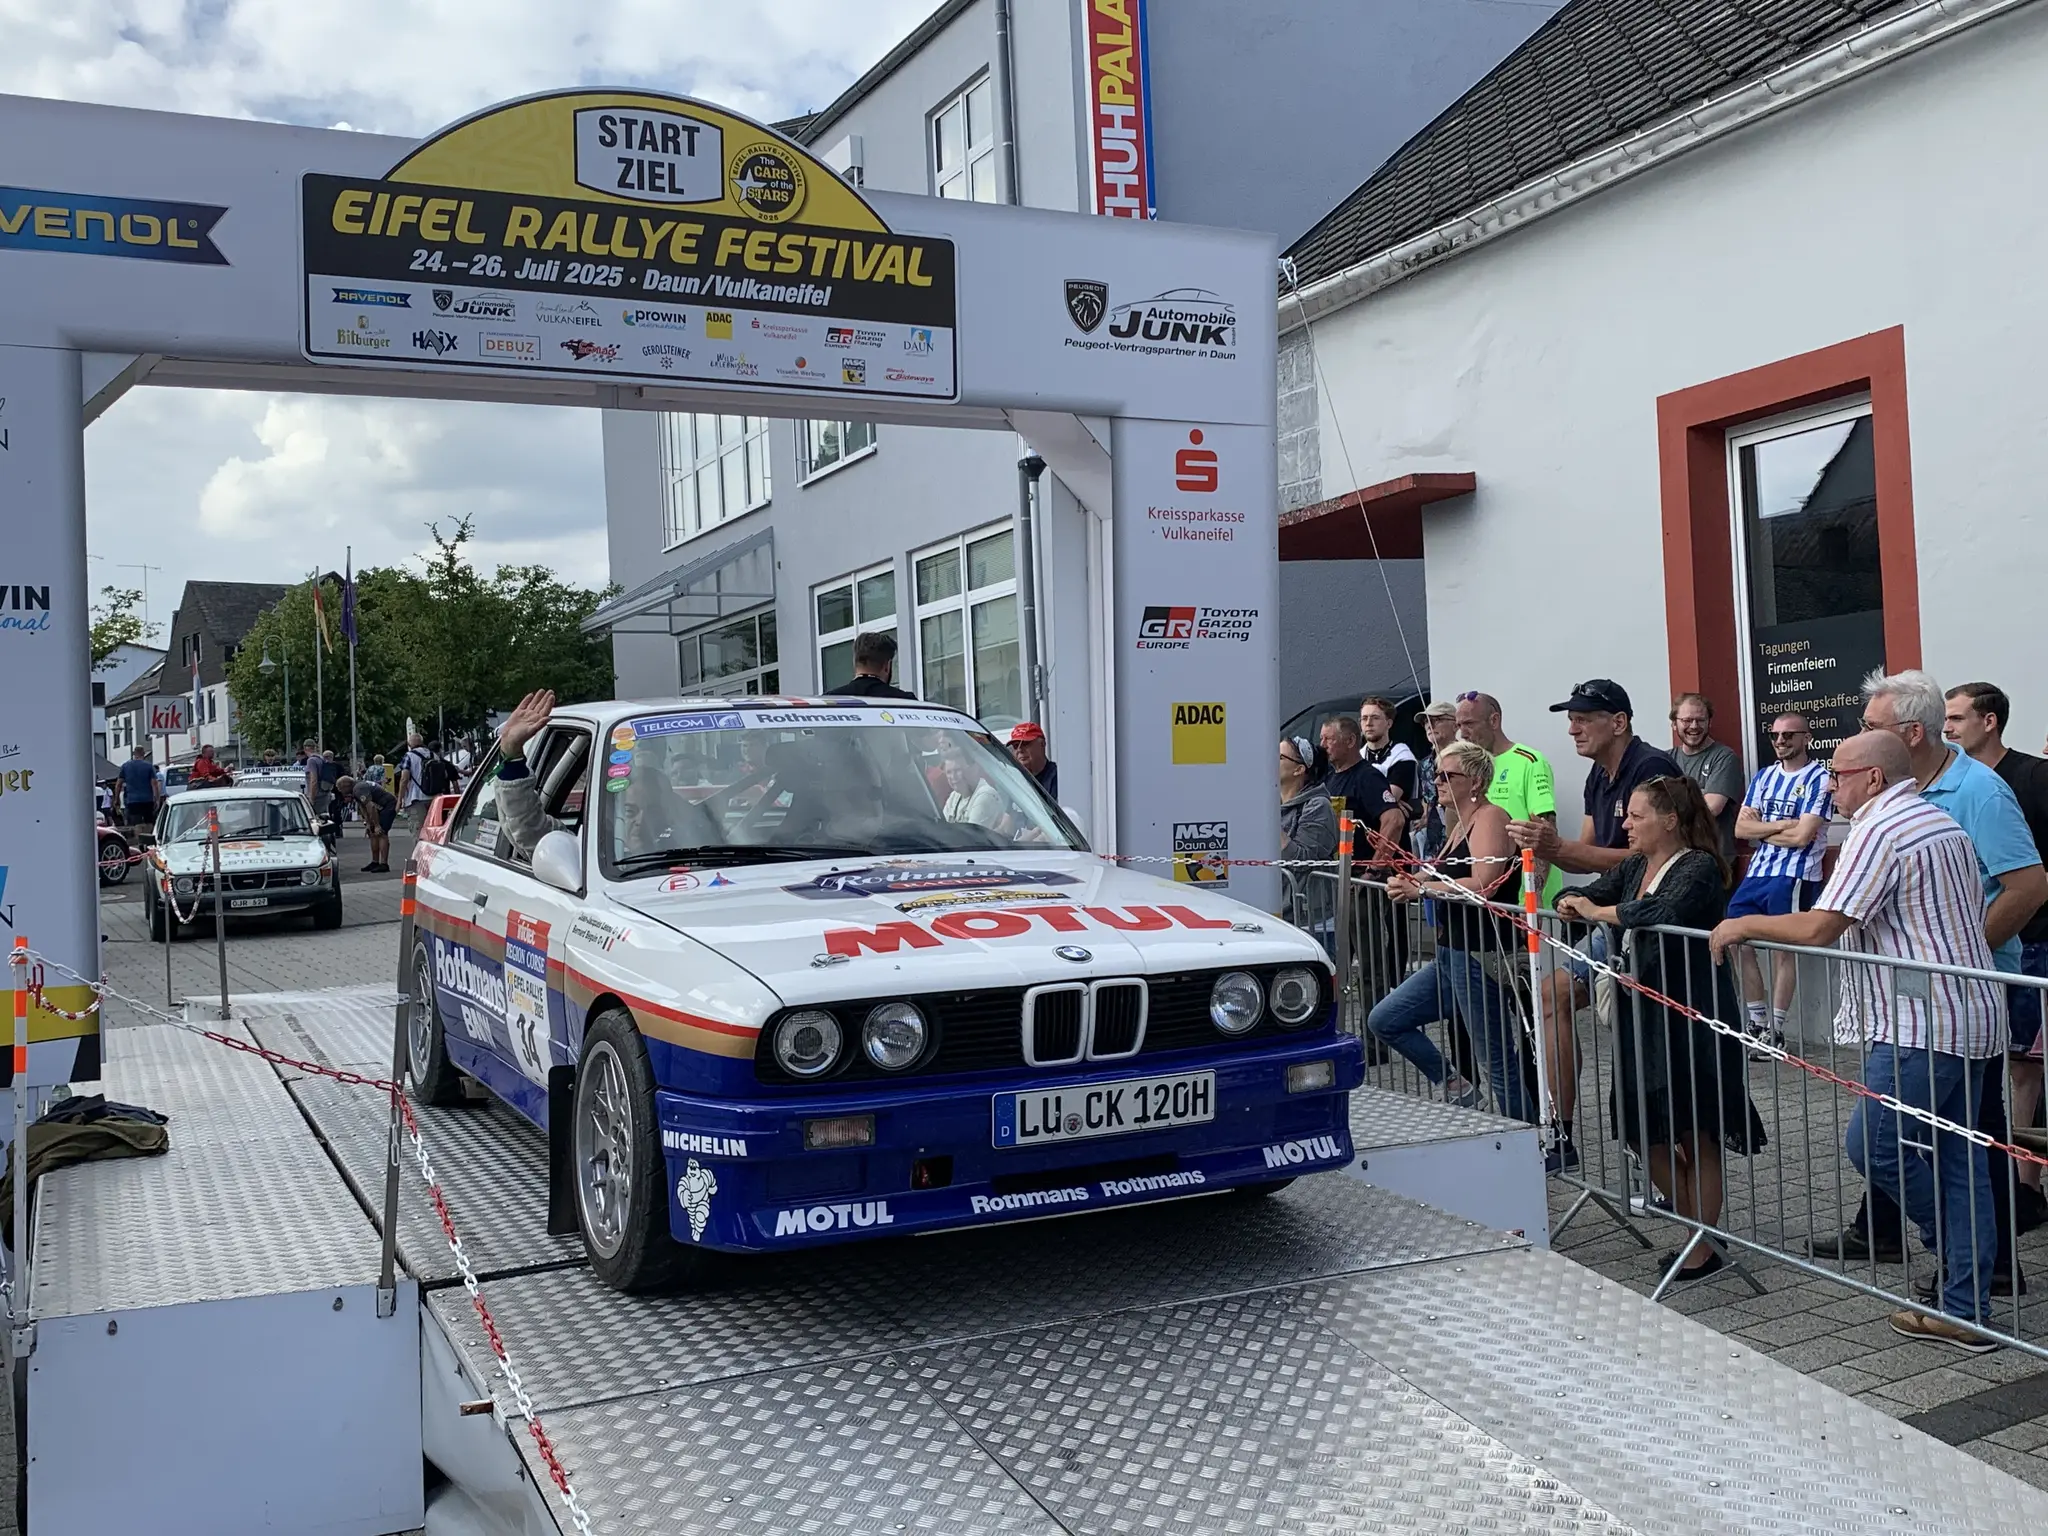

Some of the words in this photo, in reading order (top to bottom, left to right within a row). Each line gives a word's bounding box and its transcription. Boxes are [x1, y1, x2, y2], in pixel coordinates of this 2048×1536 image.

[598, 115, 700, 158] START
[760, 156, 775, 166] The
[616, 156, 685, 195] ZIEL
[754, 165, 788, 180] CARS
[780, 181, 794, 190] the
[747, 187, 789, 202] STARS
[758, 213, 778, 221] 2025
[331, 189, 487, 244] EIFEL
[502, 205, 705, 265] RALLYE
[714, 226, 934, 288] FESTIVAL
[514, 256, 560, 282] Juli
[564, 261, 624, 288] 2025
[642, 269, 832, 308] Daun/Vulkaneifel
[1068, 283, 1105, 292] PEUGEOT
[338, 291, 406, 305] RAVENOL
[453, 301, 512, 317] JUNK
[1147, 307, 1236, 326] Automobile
[536, 313, 603, 327] VULKANEIFEL
[706, 312, 733, 324] ADAC
[856, 329, 887, 337] TOYOTA
[1109, 311, 1229, 346] JUNK
[337, 328, 391, 349] Bitburger
[486, 339, 535, 353] DEBUZ
[826, 333, 854, 343] GR
[855, 334, 883, 342] GAZOO
[642, 344, 690, 360] GEROLSTEINER
[903, 341, 934, 354] DAUN
[1064, 338, 1197, 358] Peugeot-Vertragspartner
[1198, 349, 1207, 358] in
[1210, 350, 1236, 360] Daun
[844, 358, 865, 367] MSC
[1148, 506, 1245, 524] Kreissparkasse
[1161, 526, 1233, 541] Vulkaneifel
[1200, 607, 1259, 618] TOYOTA
[1140, 619, 1193, 638] GR
[1198, 618, 1252, 628] GAZOO
[1196, 629, 1249, 641] Racing
[1759, 639, 1810, 657] Tagungen
[1768, 657, 1836, 675] Firmenfeiern
[1769, 679, 1813, 695] Jubiläen
[1760, 693, 1859, 714] Beerdigungskaffee
[755, 713, 862, 724] Rothmans
[925, 714, 964, 725] CORSE
[1174, 705, 1224, 726] ADAC
[641, 719, 704, 733] TELECOM
[1175, 823, 1227, 839] MSC
[1175, 840, 1206, 850] Daun
[1208, 838, 1227, 850] e.V.
[824, 905, 1233, 958] MOTUL
[526, 951, 545, 974] CORSE
[435, 937, 508, 1016] Rothmans
[513, 974, 525, 993] EIFEL
[460, 1003, 497, 1050] BMW
[1019, 1096, 1062, 1138] LU
[1085, 1088, 1125, 1130] CK
[1133, 1078, 1209, 1124] 120H
[1001, 1124, 1010, 1138] D
[662, 1130, 748, 1157] MICHELIN
[1261, 1134, 1343, 1170] MOTUL
[970, 1184, 1090, 1215] Rothmans
[1100, 1168, 1206, 1199] Rothmans
[774, 1201, 894, 1237] MOTUL
